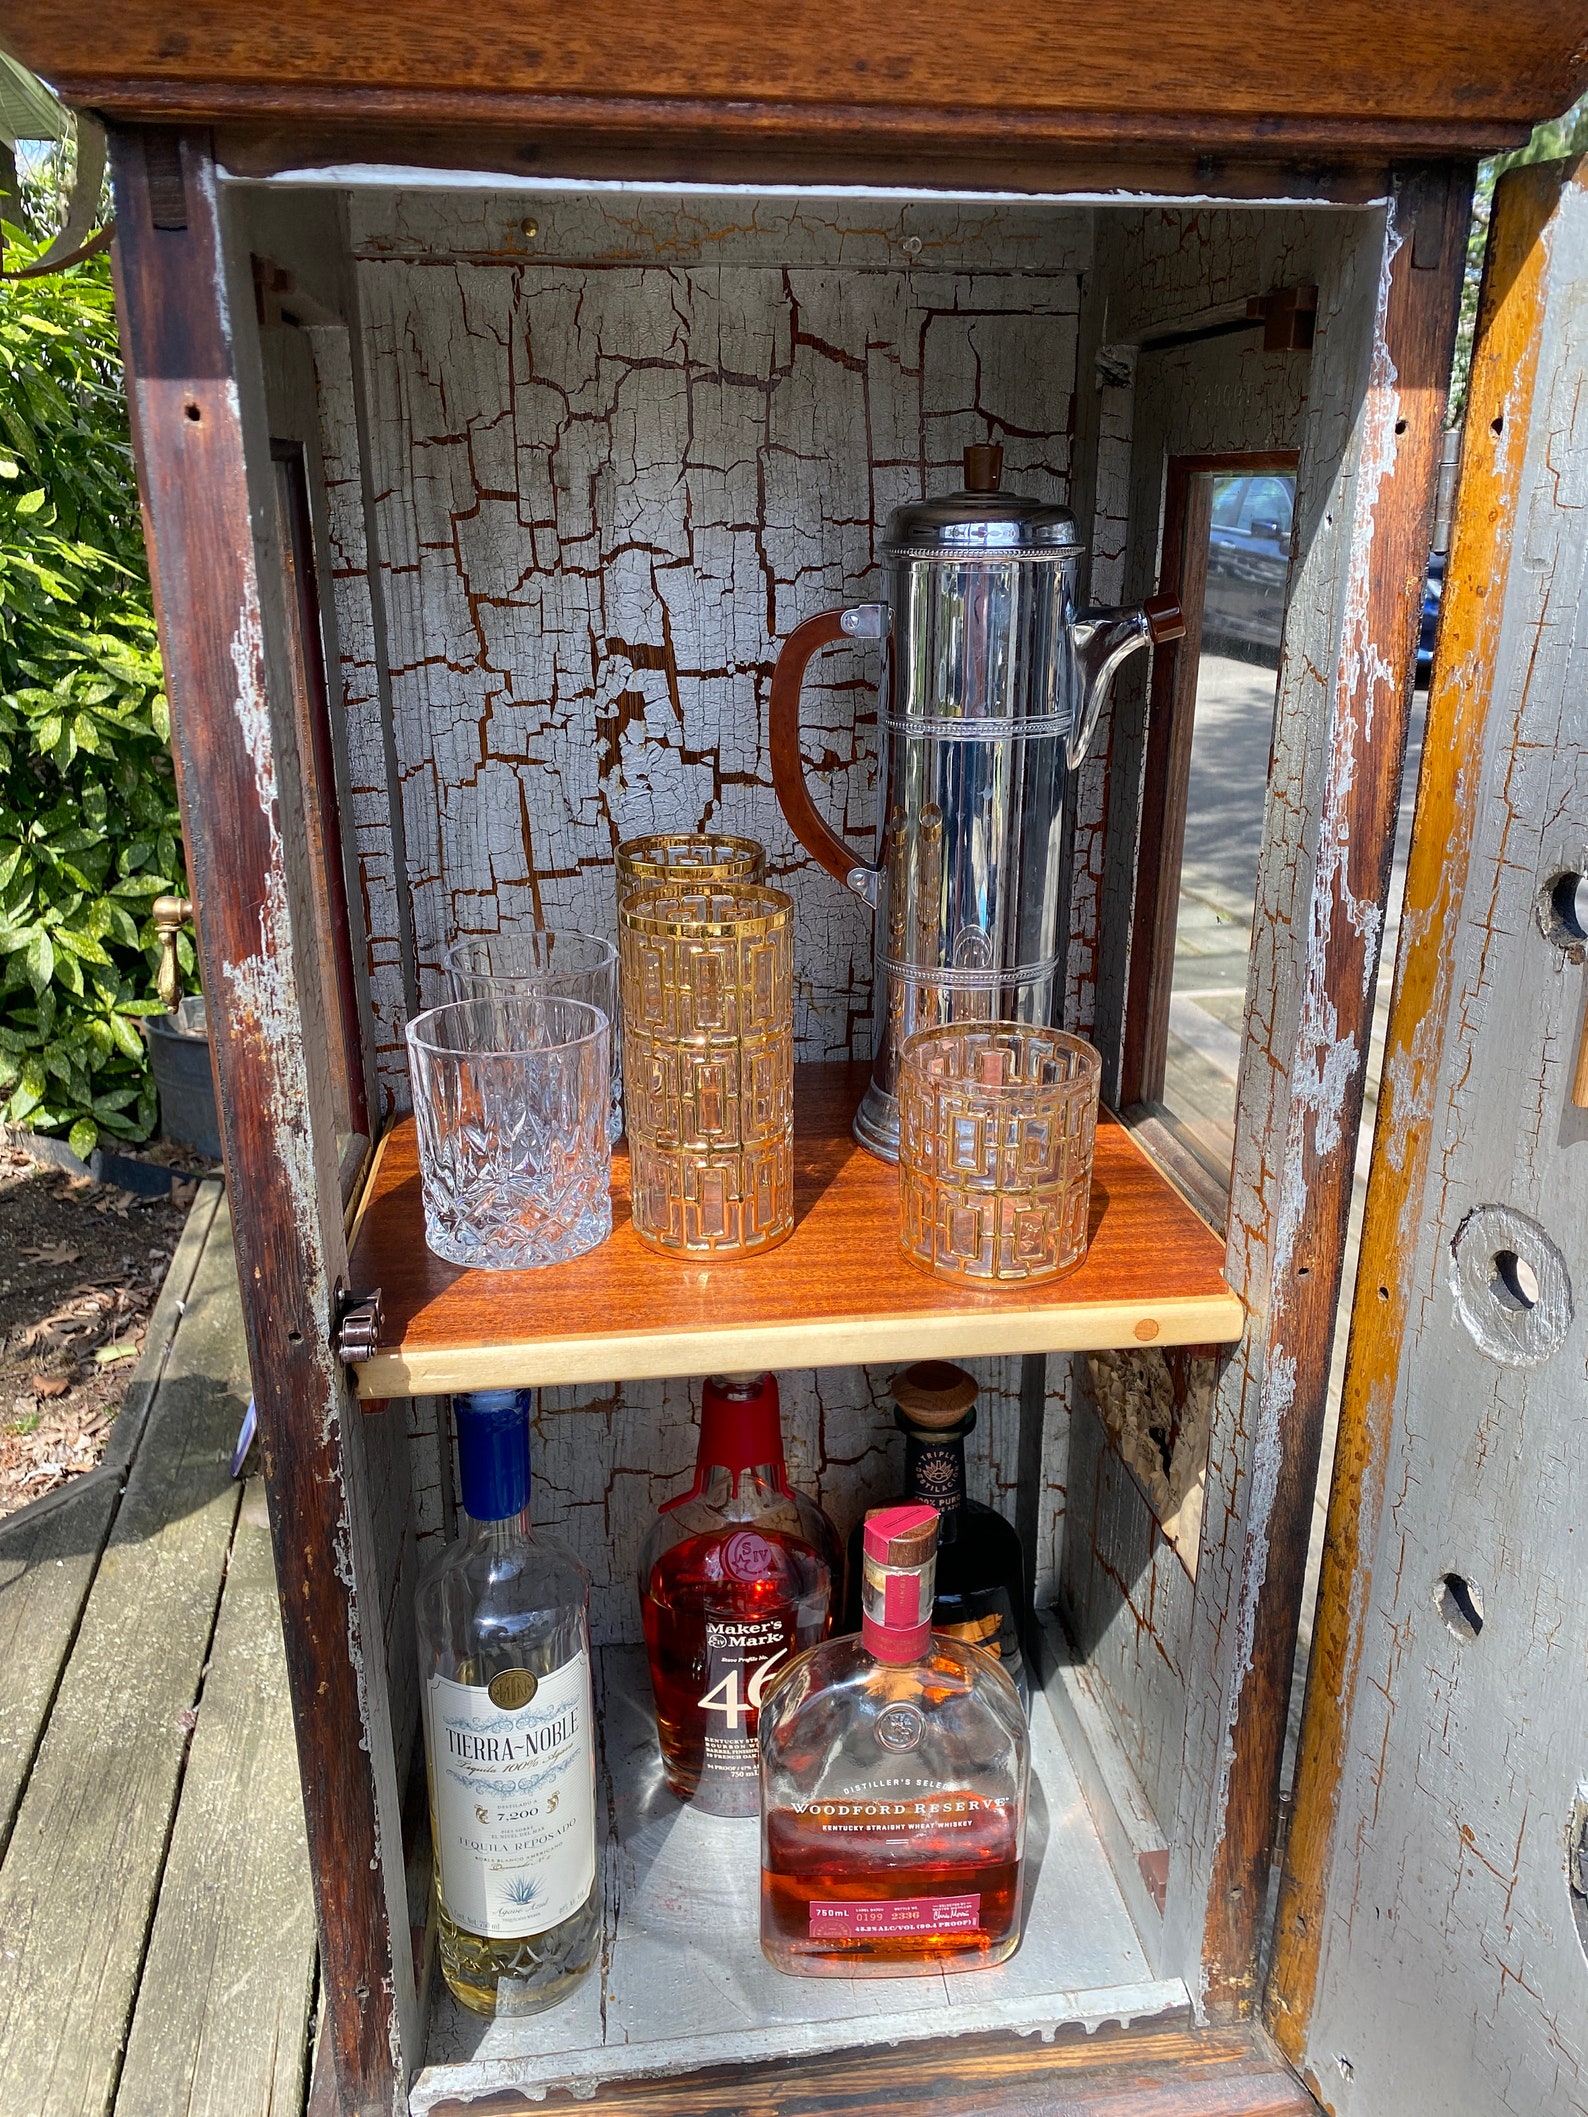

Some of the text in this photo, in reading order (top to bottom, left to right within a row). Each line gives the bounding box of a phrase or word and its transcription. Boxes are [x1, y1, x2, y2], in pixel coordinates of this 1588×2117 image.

[920, 1451, 956, 1462] TRIPLE
[706, 1620, 783, 1635] Maker's
[704, 1736, 745, 1744] KENTUCKY
[705, 1742, 746, 1750] BOURBON
[502, 1757, 539, 1774] 100%
[843, 1778, 911, 1795] DISTILLER'S
[791, 1799, 1004, 1816] WOODFORD RESERVE
[865, 1823, 906, 1831] STRAIGHT
[908, 1822, 935, 1830] WHEAT
[937, 1819, 974, 1829] WHISKEY
[514, 1817, 577, 1851] REPOSADO
[856, 1911, 920, 1922] 0199 2336
[877, 1924, 916, 1933] ALC/VOL
[938, 1919, 972, 1928] PROOF)
